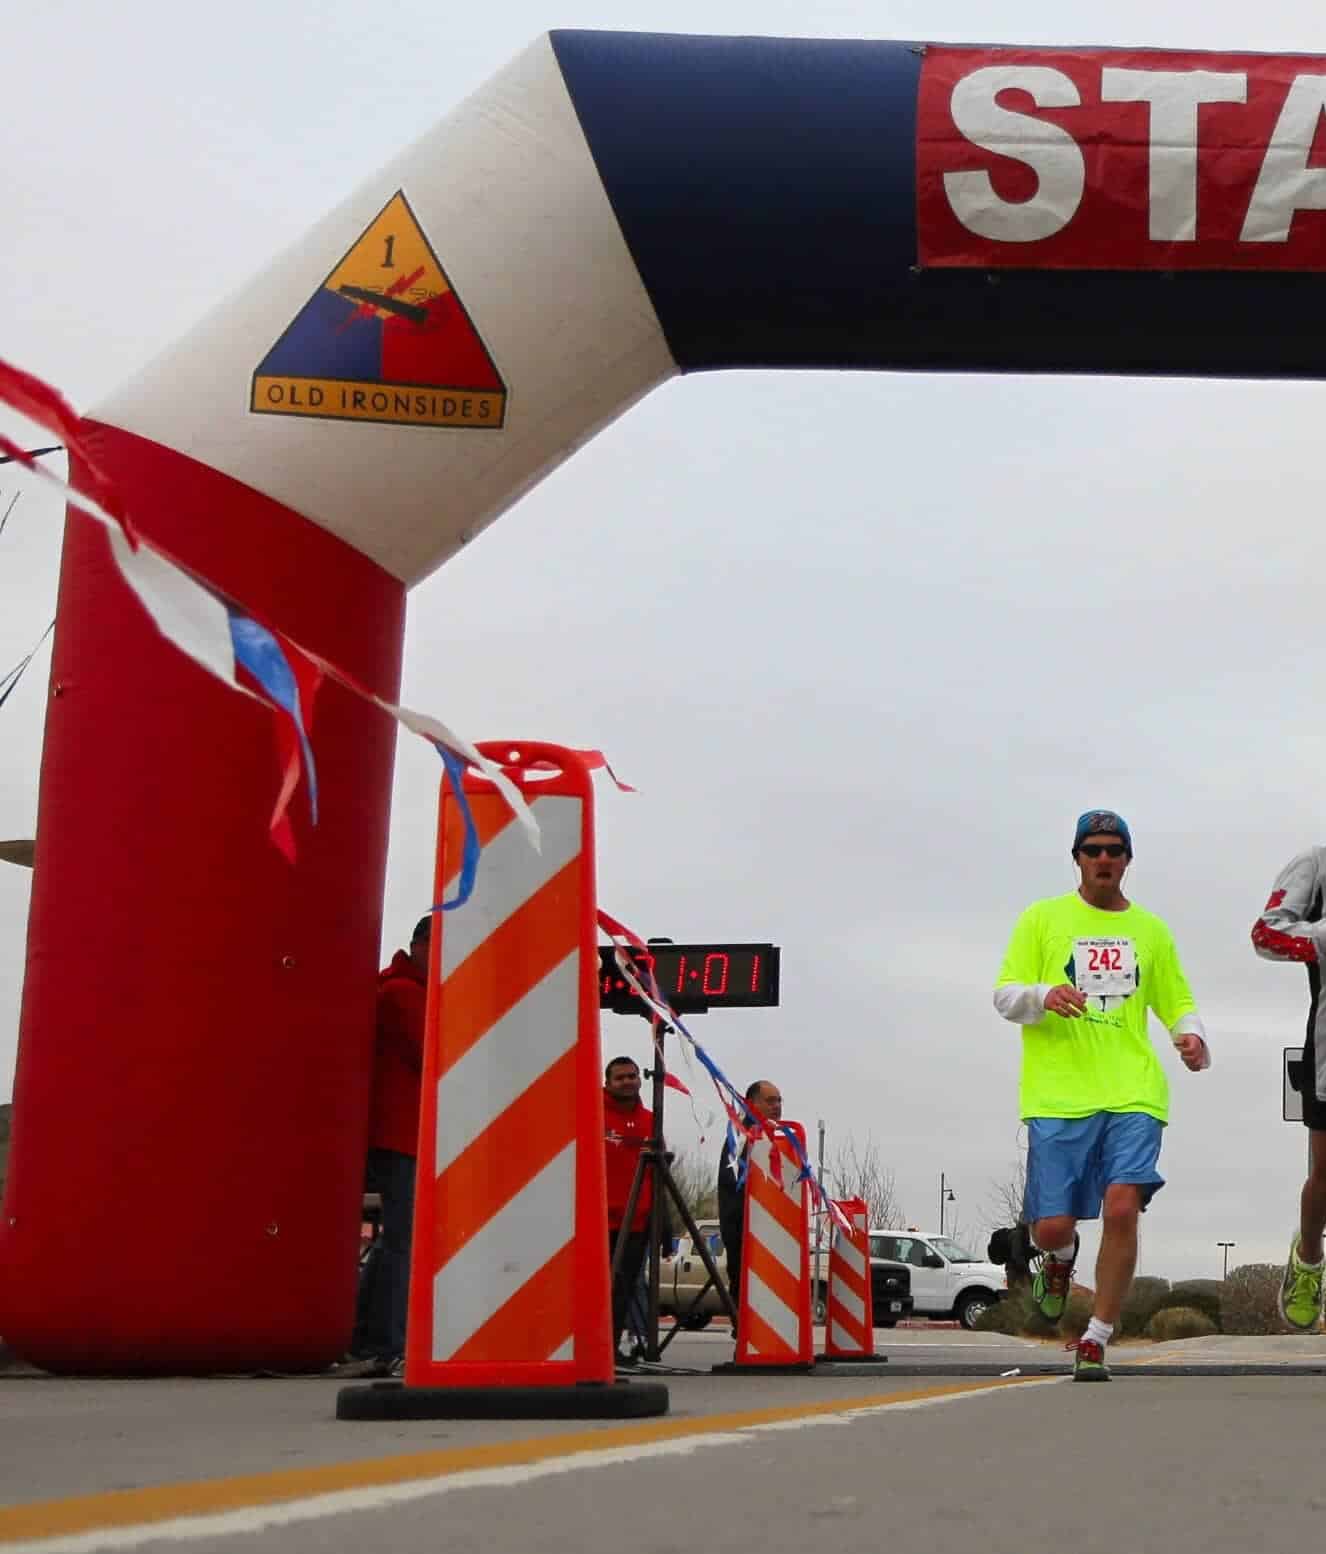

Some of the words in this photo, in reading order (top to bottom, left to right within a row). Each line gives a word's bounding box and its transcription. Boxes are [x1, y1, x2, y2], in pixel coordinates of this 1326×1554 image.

[380, 234, 395, 268] 1
[267, 384, 325, 407] OLD
[340, 390, 491, 419] IRONSIDES
[1088, 948, 1123, 971] 242
